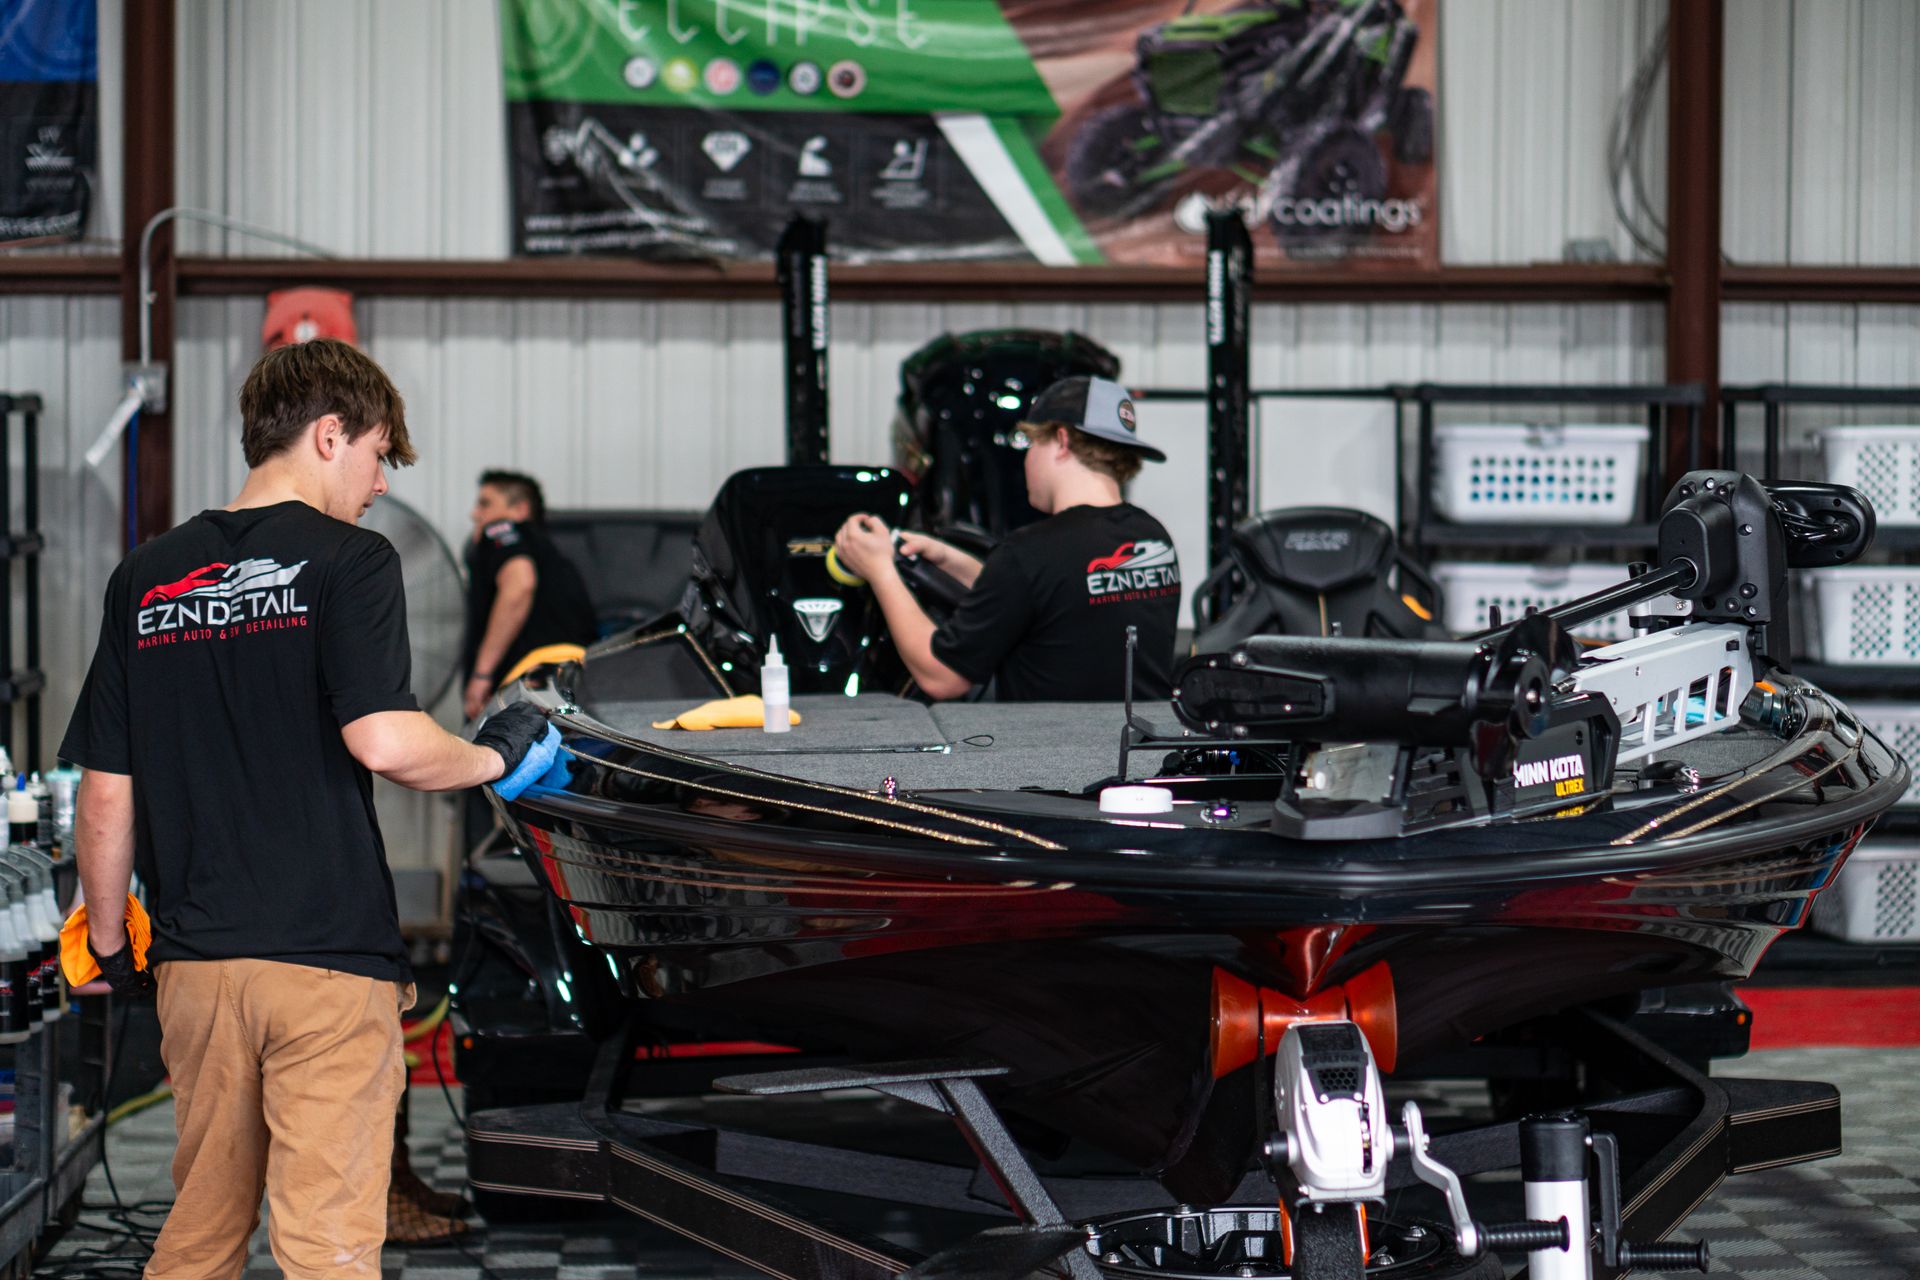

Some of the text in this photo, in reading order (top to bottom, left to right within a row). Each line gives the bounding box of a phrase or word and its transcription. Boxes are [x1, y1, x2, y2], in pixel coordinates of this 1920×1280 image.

[1272, 192, 1421, 232] coatings
[138, 632, 176, 649] MARINE
[184, 628, 212, 641] AUTO
[220, 628, 227, 640] &
[246, 615, 307, 634] DETAILING
[1513, 754, 1584, 788] MINN KOTA
